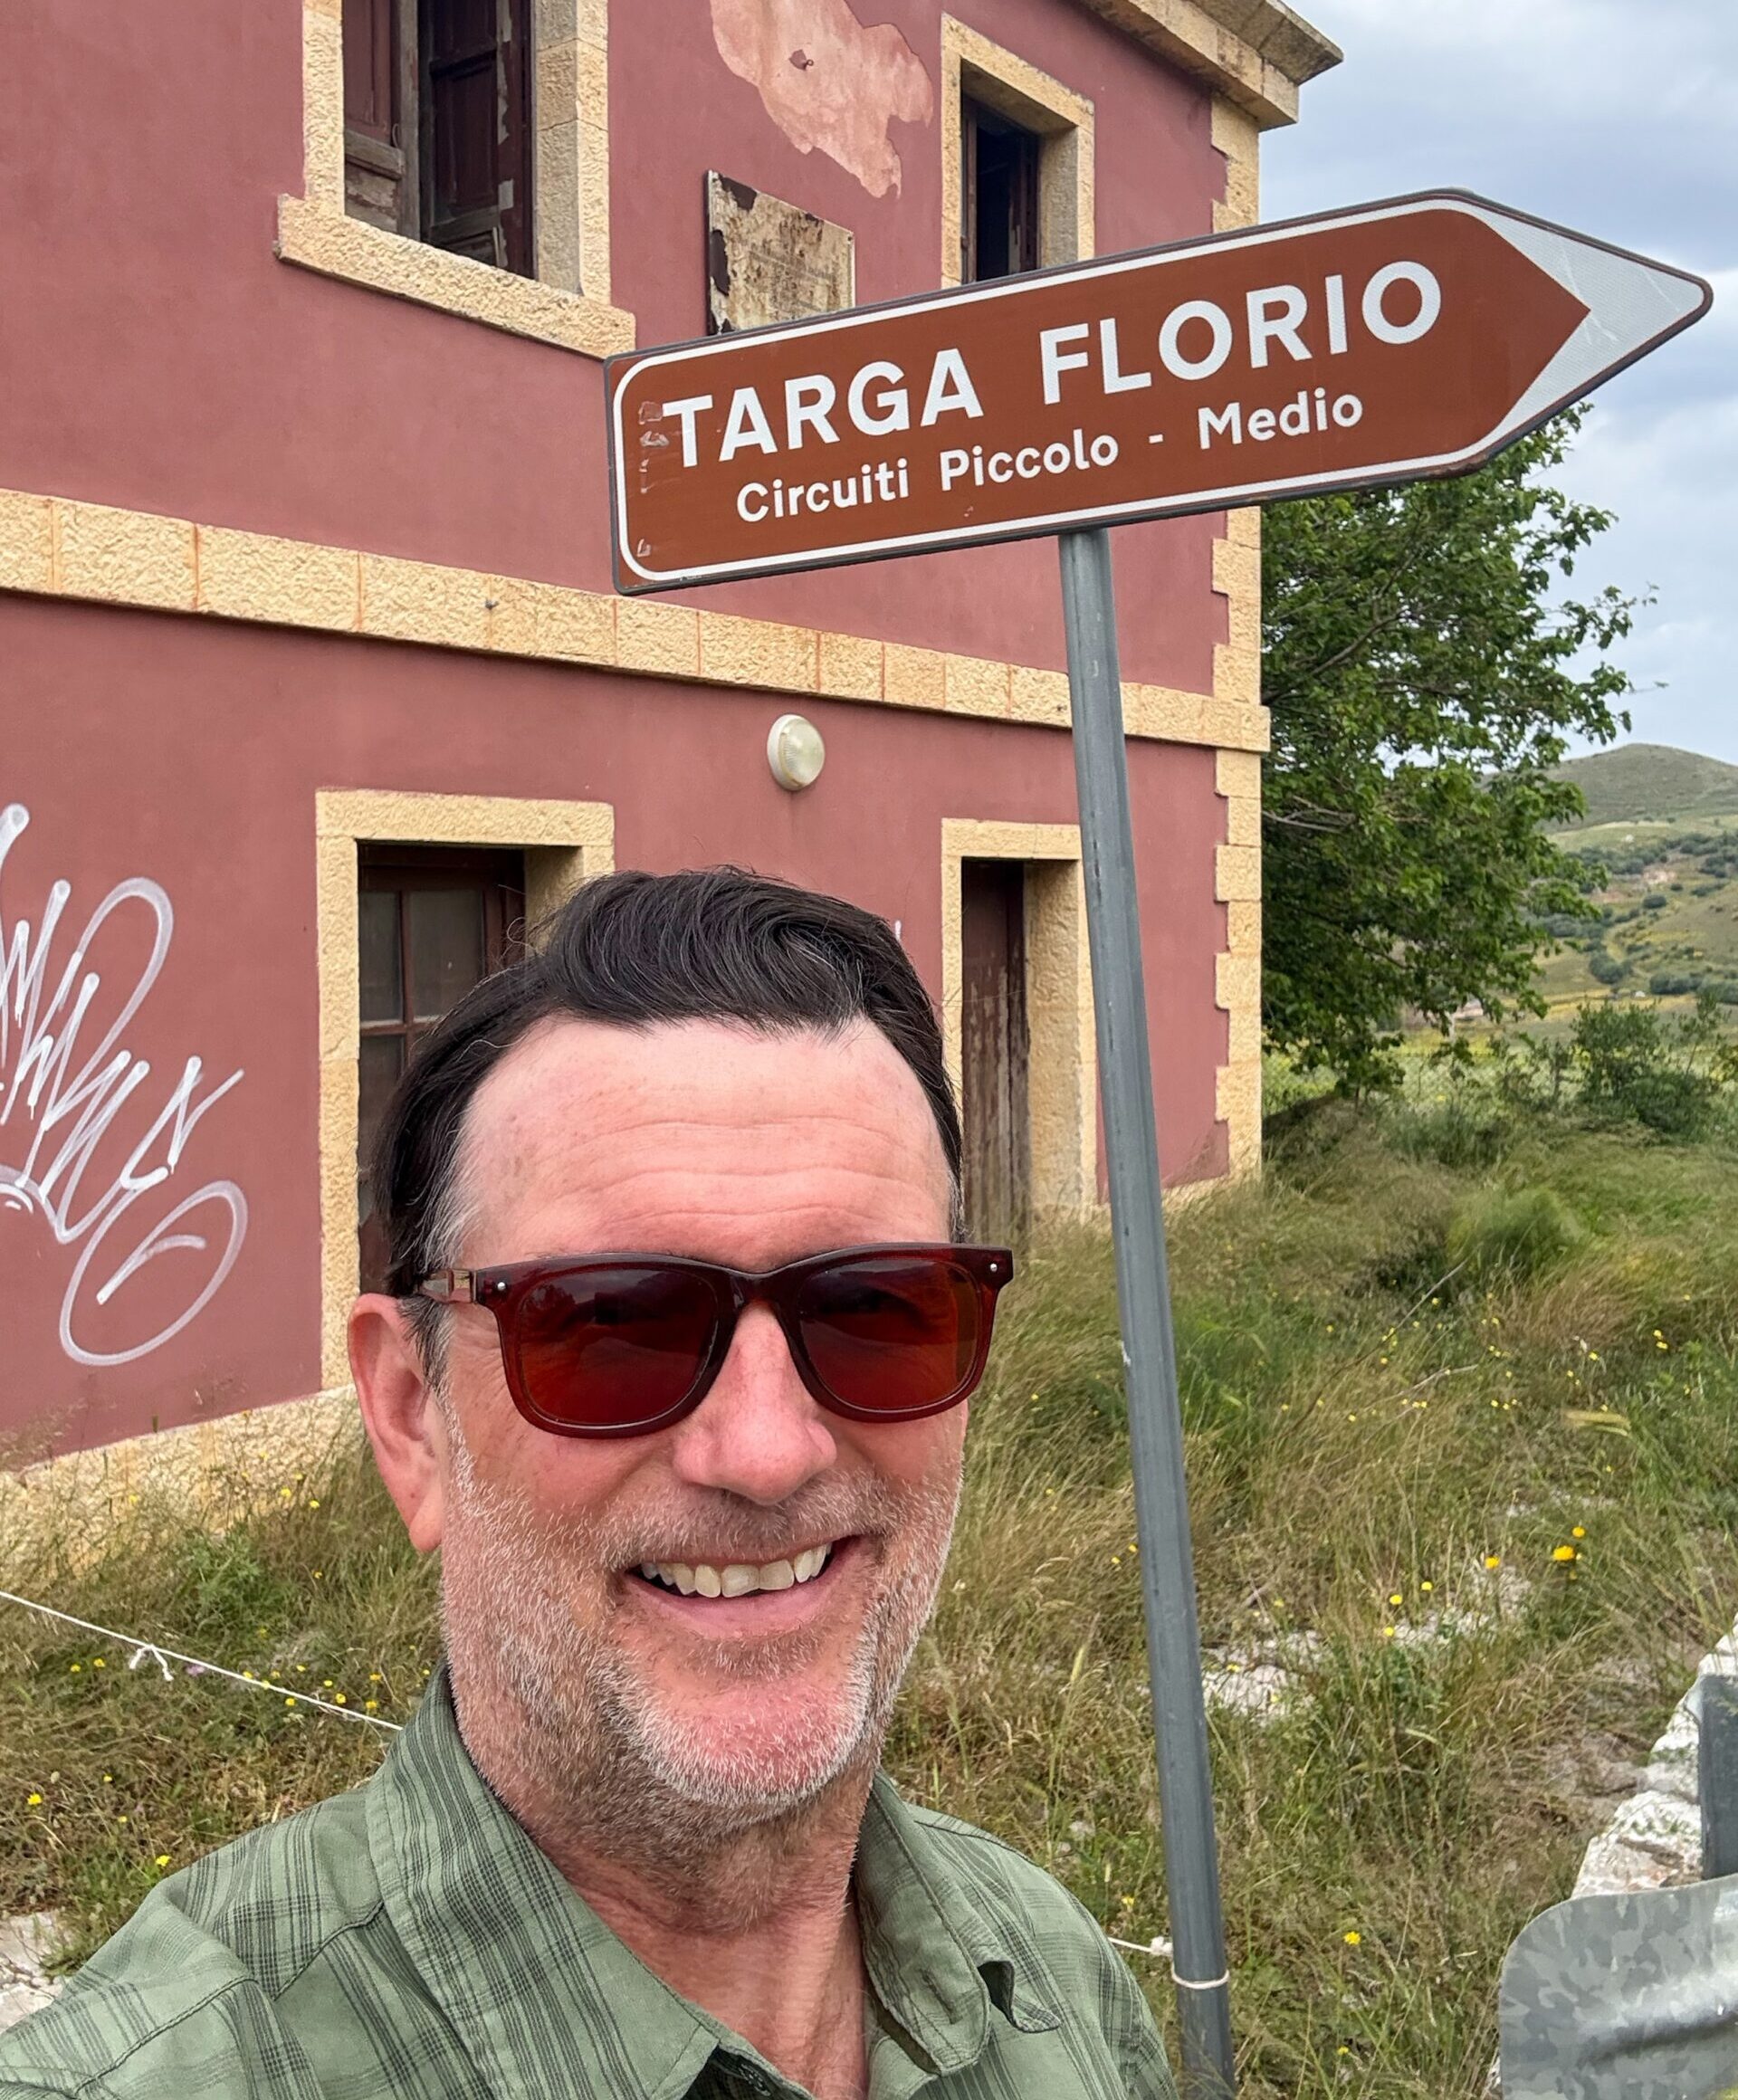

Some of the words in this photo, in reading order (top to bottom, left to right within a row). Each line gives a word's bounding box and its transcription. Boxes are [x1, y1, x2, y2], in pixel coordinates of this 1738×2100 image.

[662, 348, 984, 468] TARGA
[1039, 261, 1441, 406] FLORIO
[737, 457, 909, 522] Circuiti
[940, 428, 1119, 492] Piccolo
[1149, 433, 1163, 444] -
[1198, 387, 1363, 450] Medio
